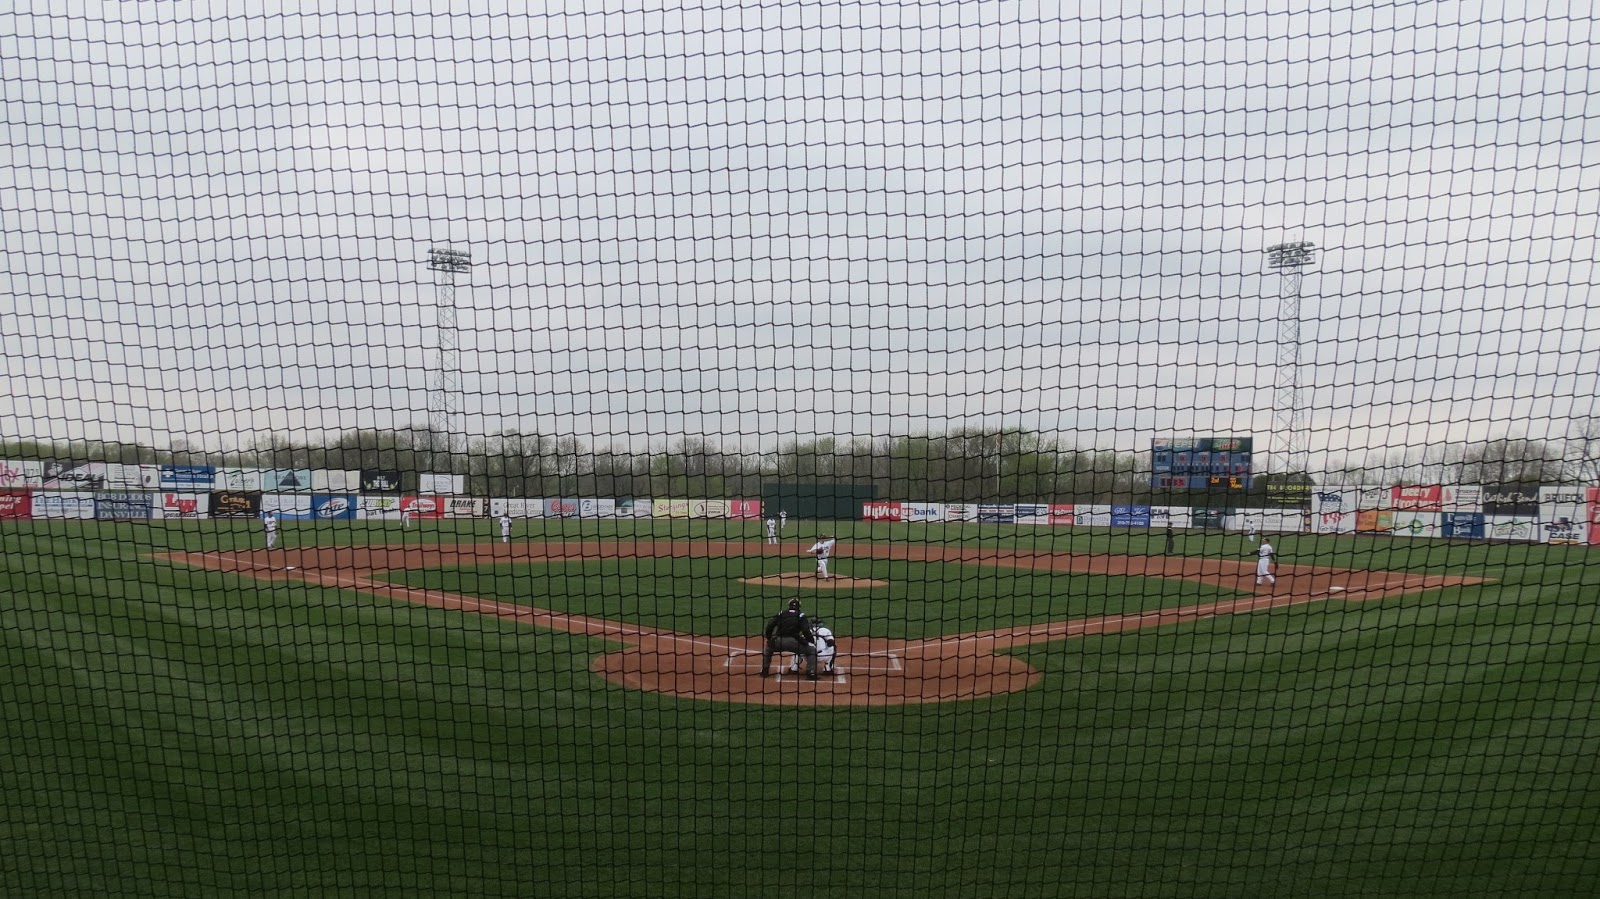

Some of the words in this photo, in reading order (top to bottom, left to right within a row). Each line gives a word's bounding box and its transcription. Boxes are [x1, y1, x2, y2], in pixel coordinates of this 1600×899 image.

[361, 499, 394, 507] SUBWAY
[450, 500, 476, 508] BRAKE
[1550, 532, 1580, 540] CASE
